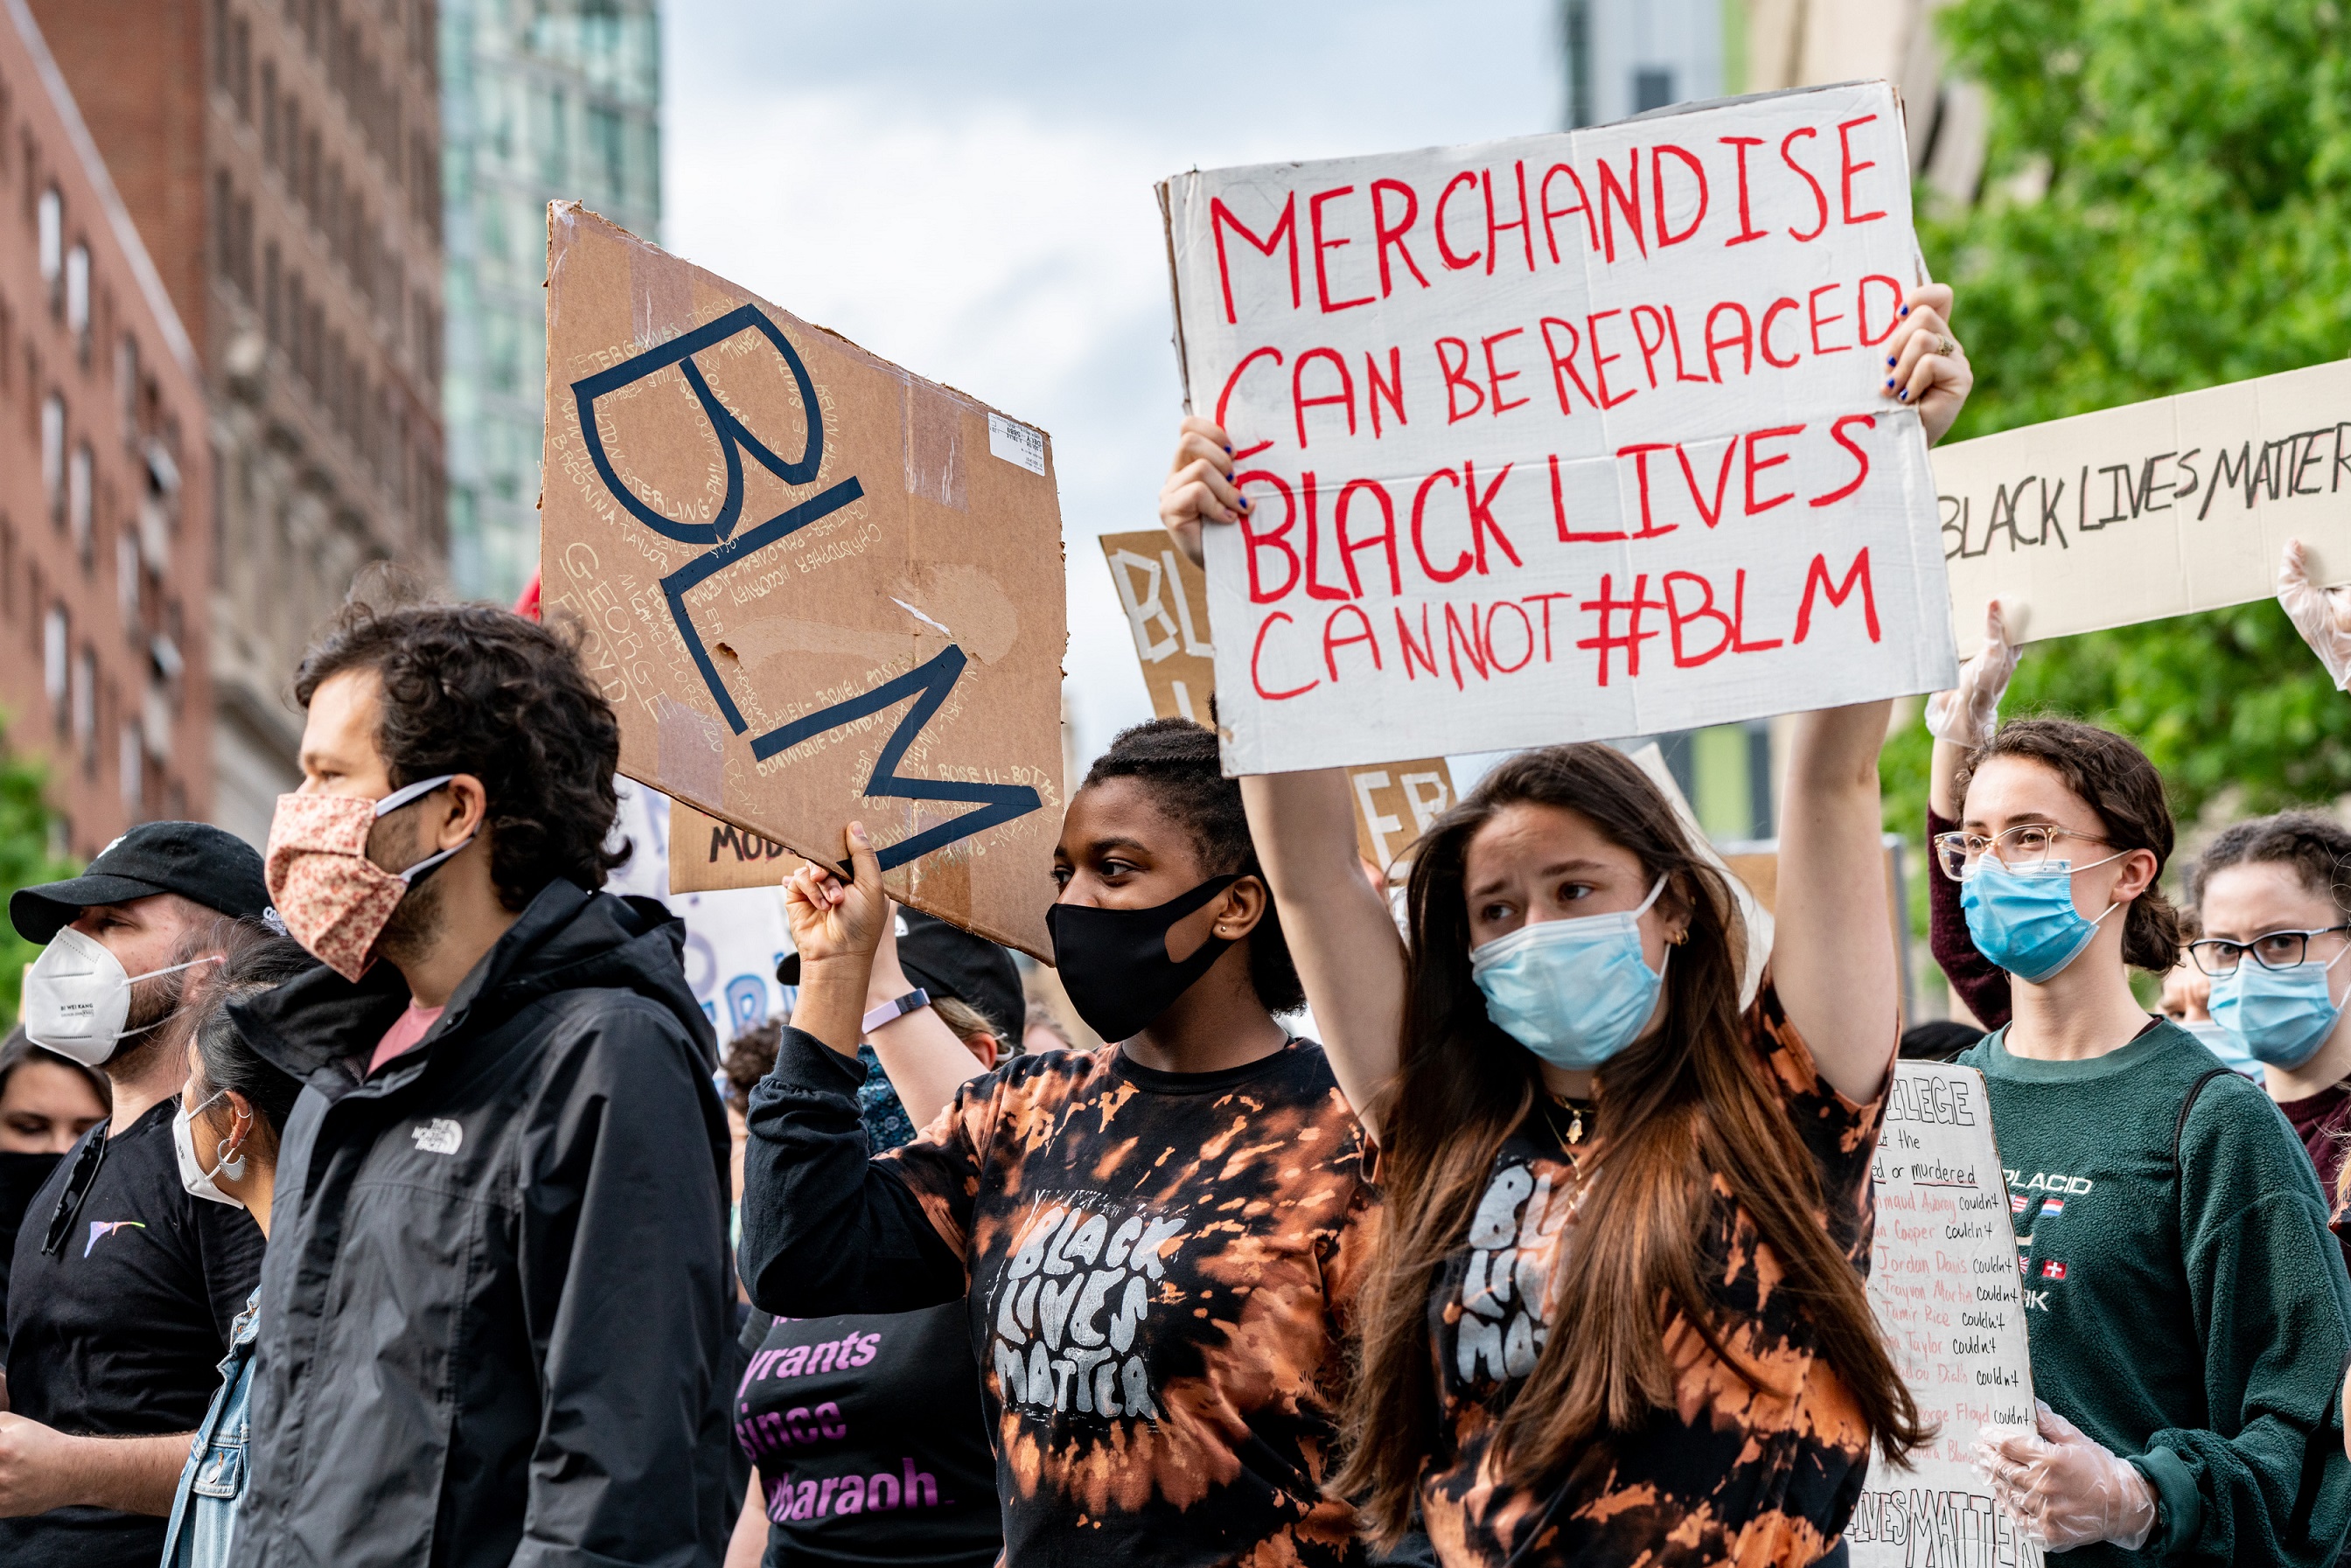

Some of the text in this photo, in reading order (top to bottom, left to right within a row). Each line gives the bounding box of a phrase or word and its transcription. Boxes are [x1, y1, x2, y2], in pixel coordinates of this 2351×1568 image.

[1210, 114, 1887, 324] MERCHANDISE
[1216, 273, 1905, 461] CAN BE REPLACED
[552, 434, 616, 526] BREONNA
[622, 467, 712, 520] STERLING
[1234, 413, 1877, 605] BLACK LIVES
[1937, 422, 2351, 561] BLACK LIVES MATTER
[560, 542, 676, 722] GEORGE
[1250, 590, 1573, 700] CANNOT
[1577, 545, 1880, 688] #BLM
[1892, 1159, 1976, 1184] or murdered
[1898, 1129, 1921, 1149] the
[1008, 1207, 1187, 1279] BLACK
[1875, 1245, 1930, 1274] Jordan
[995, 1268, 1148, 1352] LIVES
[1925, 1305, 1950, 1327] Rice
[737, 1330, 881, 1398] yrants
[994, 1338, 1159, 1420] MATTER
[1906, 1331, 1943, 1362] Taylor
[736, 1402, 847, 1461] since
[1917, 1408, 1950, 1427] eorge
